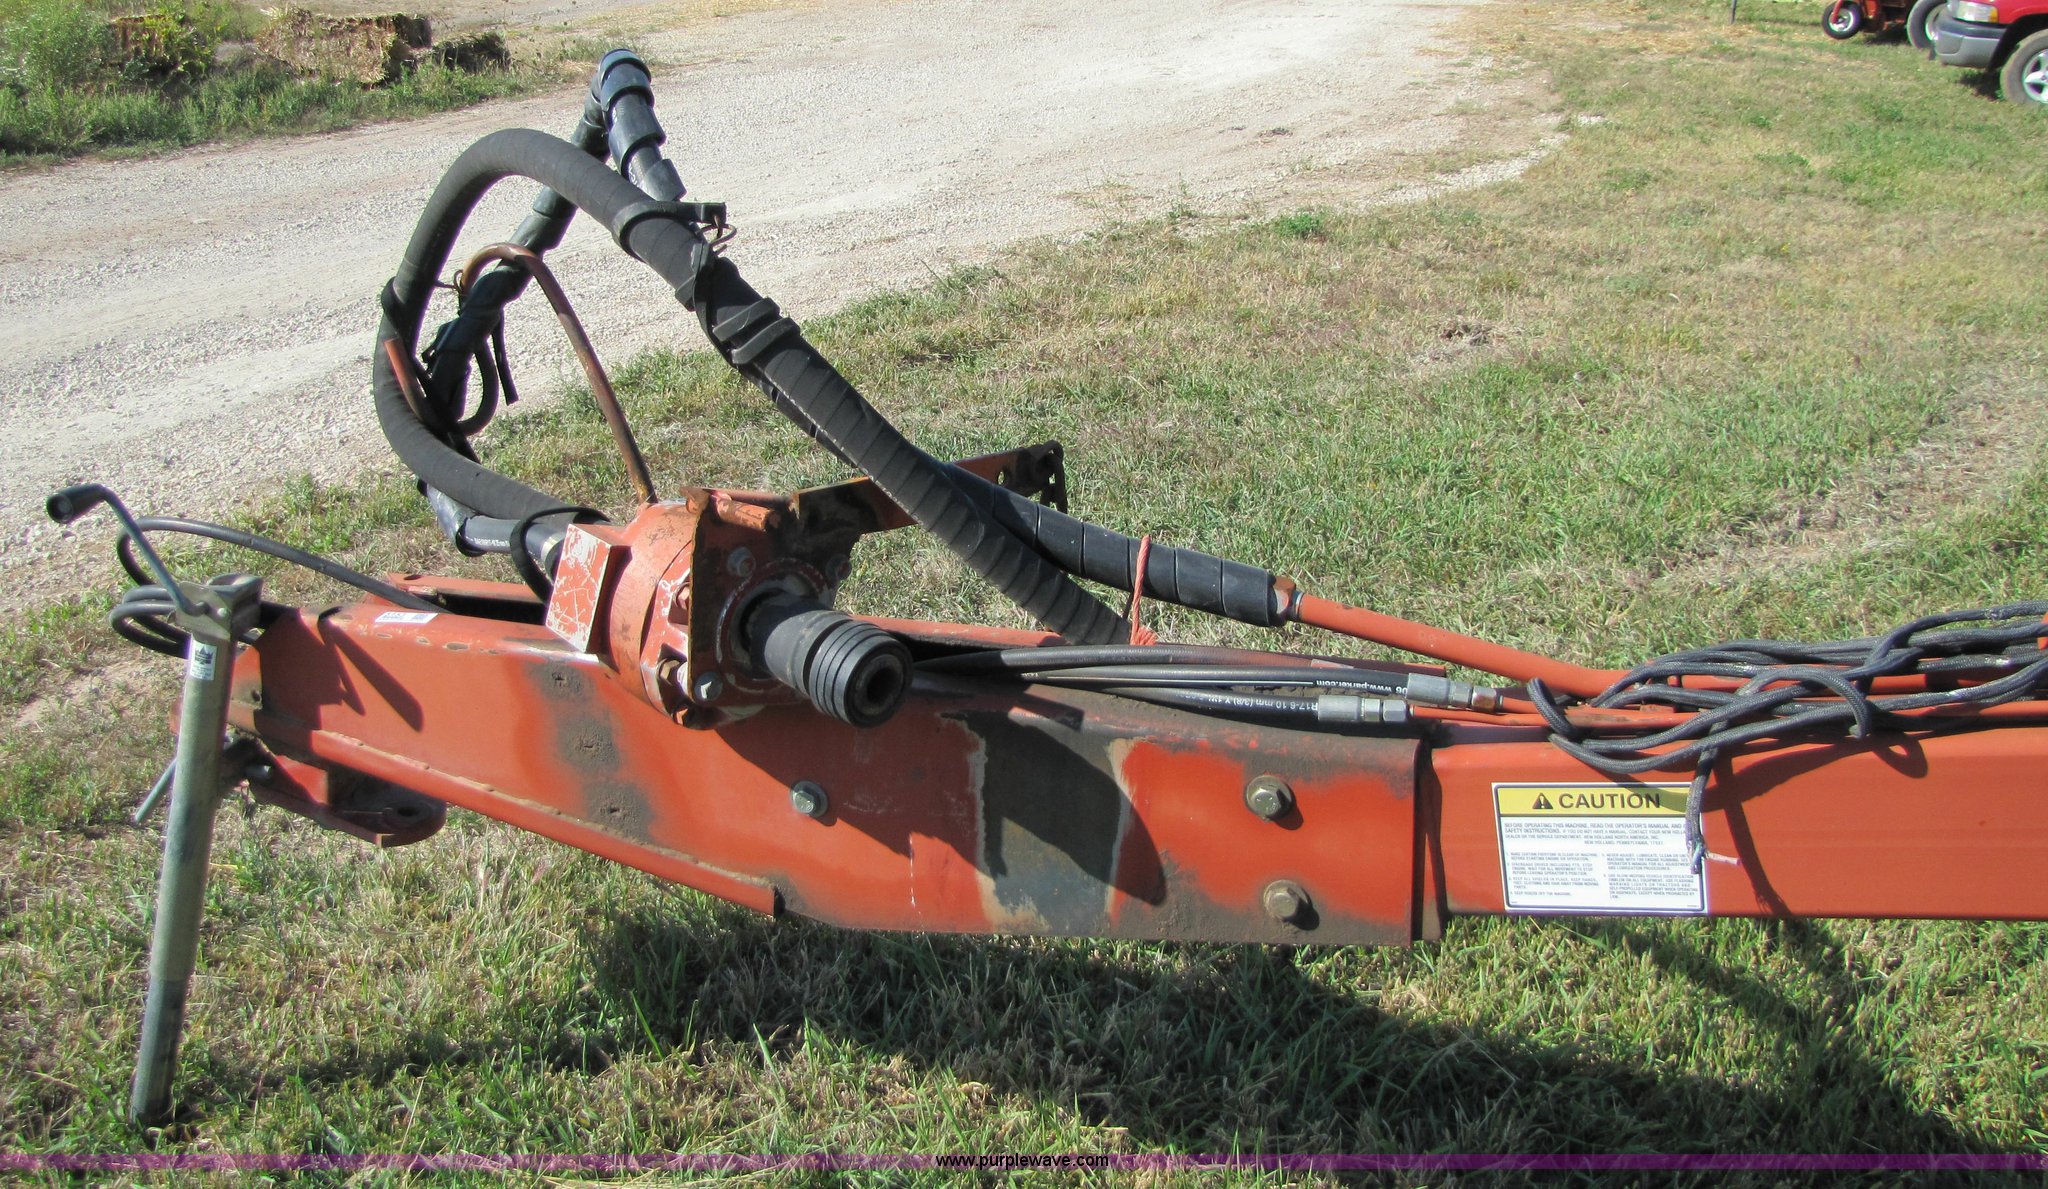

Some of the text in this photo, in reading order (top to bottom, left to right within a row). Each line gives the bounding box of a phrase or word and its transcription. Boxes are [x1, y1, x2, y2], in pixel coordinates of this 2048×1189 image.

[1316, 680, 1392, 692] www.parker.com
[1256, 699, 1274, 708] mm
[1558, 793, 1660, 809] CAUTION
